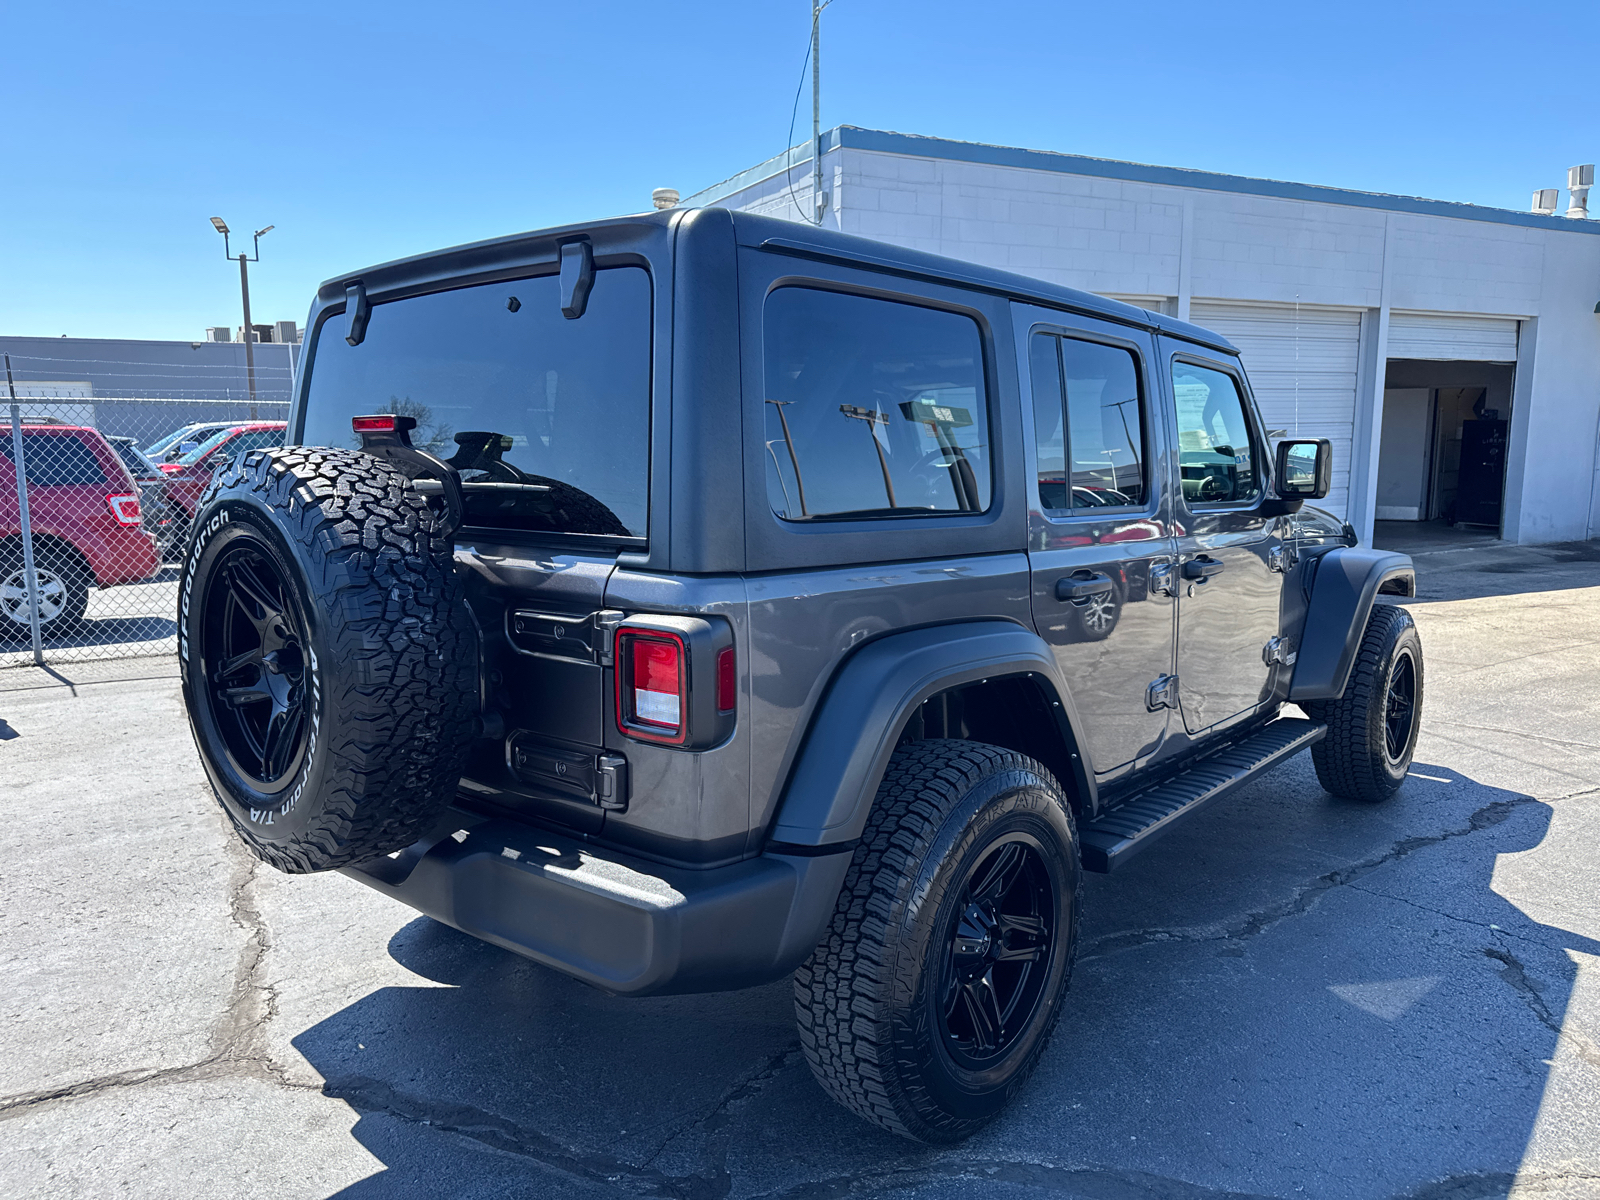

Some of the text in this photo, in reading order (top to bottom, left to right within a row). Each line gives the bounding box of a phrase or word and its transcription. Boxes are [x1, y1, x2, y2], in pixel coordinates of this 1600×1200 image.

[181, 508, 230, 662] BFGoodrich
[250, 645, 321, 825] All-Terrain T/A
